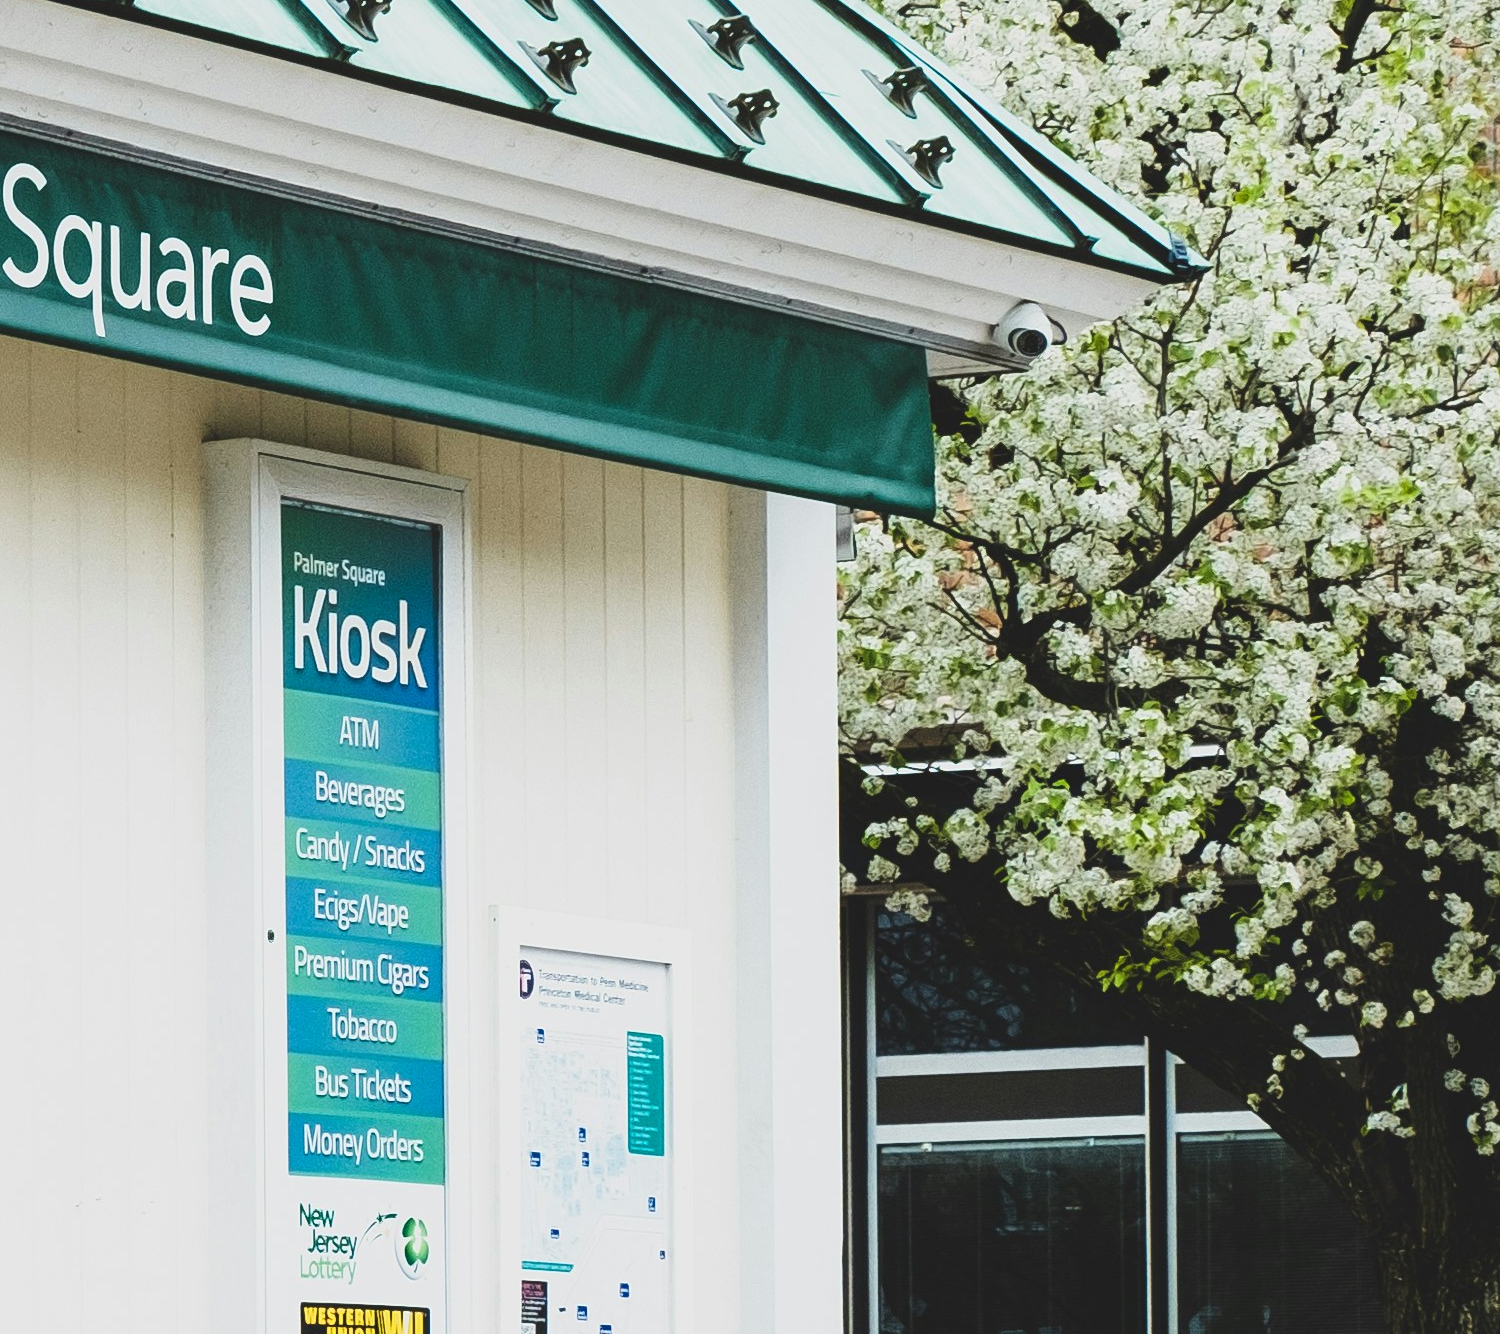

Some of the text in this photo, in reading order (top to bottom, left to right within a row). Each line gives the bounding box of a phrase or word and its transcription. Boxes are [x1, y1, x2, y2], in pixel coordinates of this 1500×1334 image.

[1, 162, 275, 337] Square
[294, 552, 385, 586] Palmer Square
[295, 585, 427, 688] Kiosk
[340, 716, 378, 749] ATM
[316, 771, 405, 817] Beverages
[296, 827, 425, 872] Candy / Snacks
[315, 889, 408, 934] Ecigs/Vape
[295, 945, 429, 994] Premium Cigars
[327, 1008, 397, 1042] Tobacco
[315, 1066, 411, 1102] Bus Tickets
[304, 1124, 423, 1165] Money Orders
[300, 1204, 334, 1227] New
[308, 1230, 357, 1259] Jersey
[300, 1254, 357, 1285] Lottery
[304, 1307, 375, 1326] WESTERN
